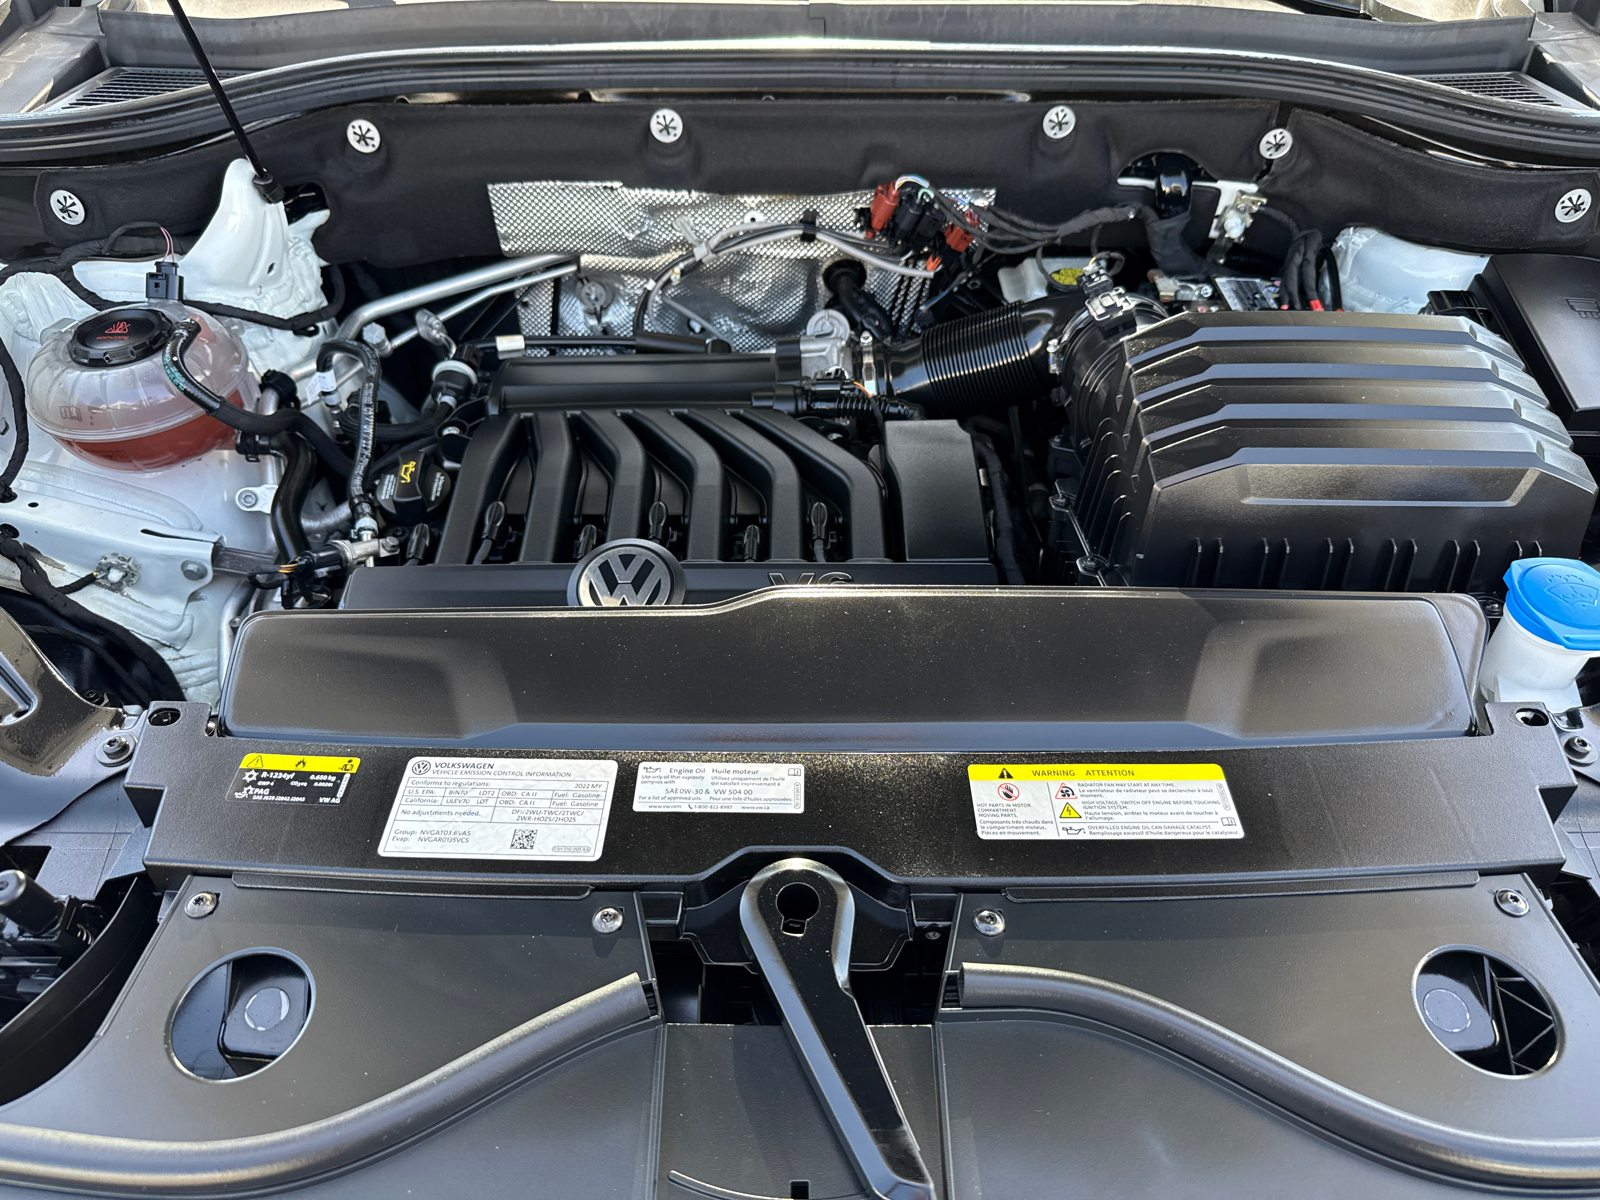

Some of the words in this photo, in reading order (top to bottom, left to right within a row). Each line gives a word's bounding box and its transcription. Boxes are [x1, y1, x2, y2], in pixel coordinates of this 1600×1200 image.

[434, 762, 495, 770] VOLKSWAGEN
[261, 771, 296, 780] R-1234yf
[452, 780, 491, 788] regulations:
[319, 796, 330, 804] VW
